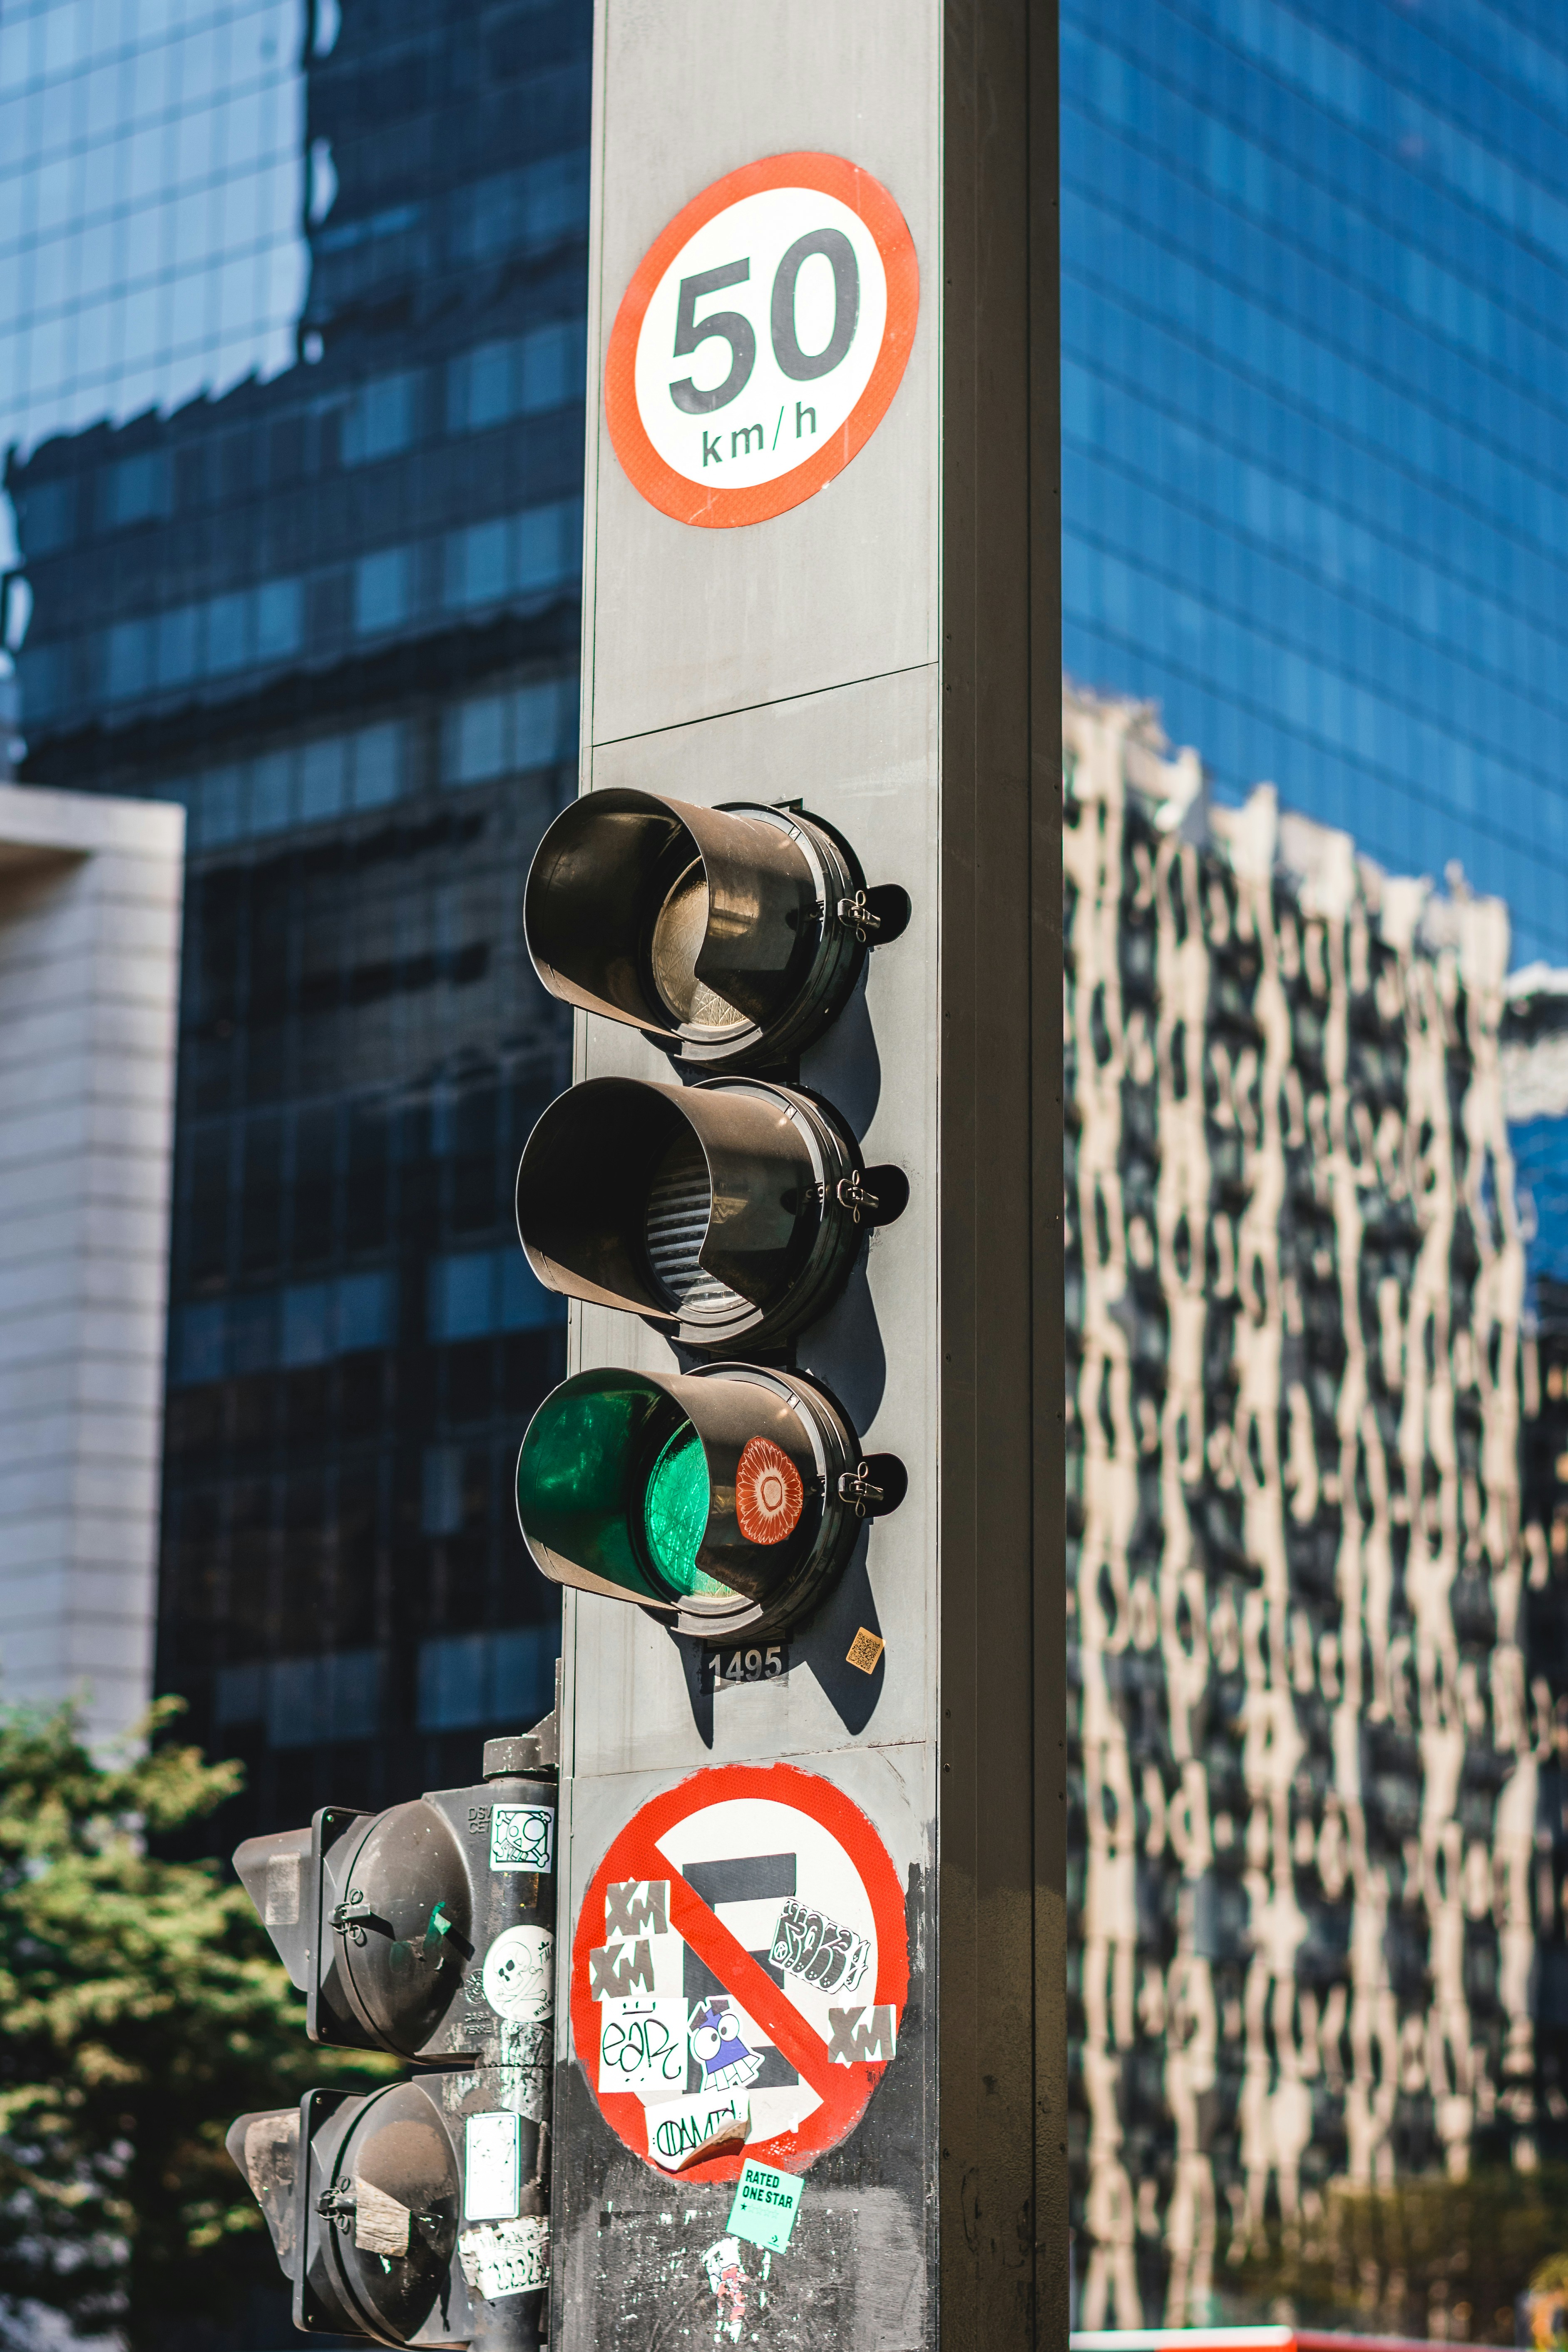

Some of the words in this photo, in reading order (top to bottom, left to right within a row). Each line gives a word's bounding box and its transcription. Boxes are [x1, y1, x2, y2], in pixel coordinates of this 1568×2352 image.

[668, 228, 860, 415] 50
[702, 401, 817, 467] km/h
[709, 1646, 782, 1686] 1495
[742, 2185, 764, 2202] ONE
[765, 2190, 793, 2209] STAR
[745, 2169, 780, 2188] RATED
